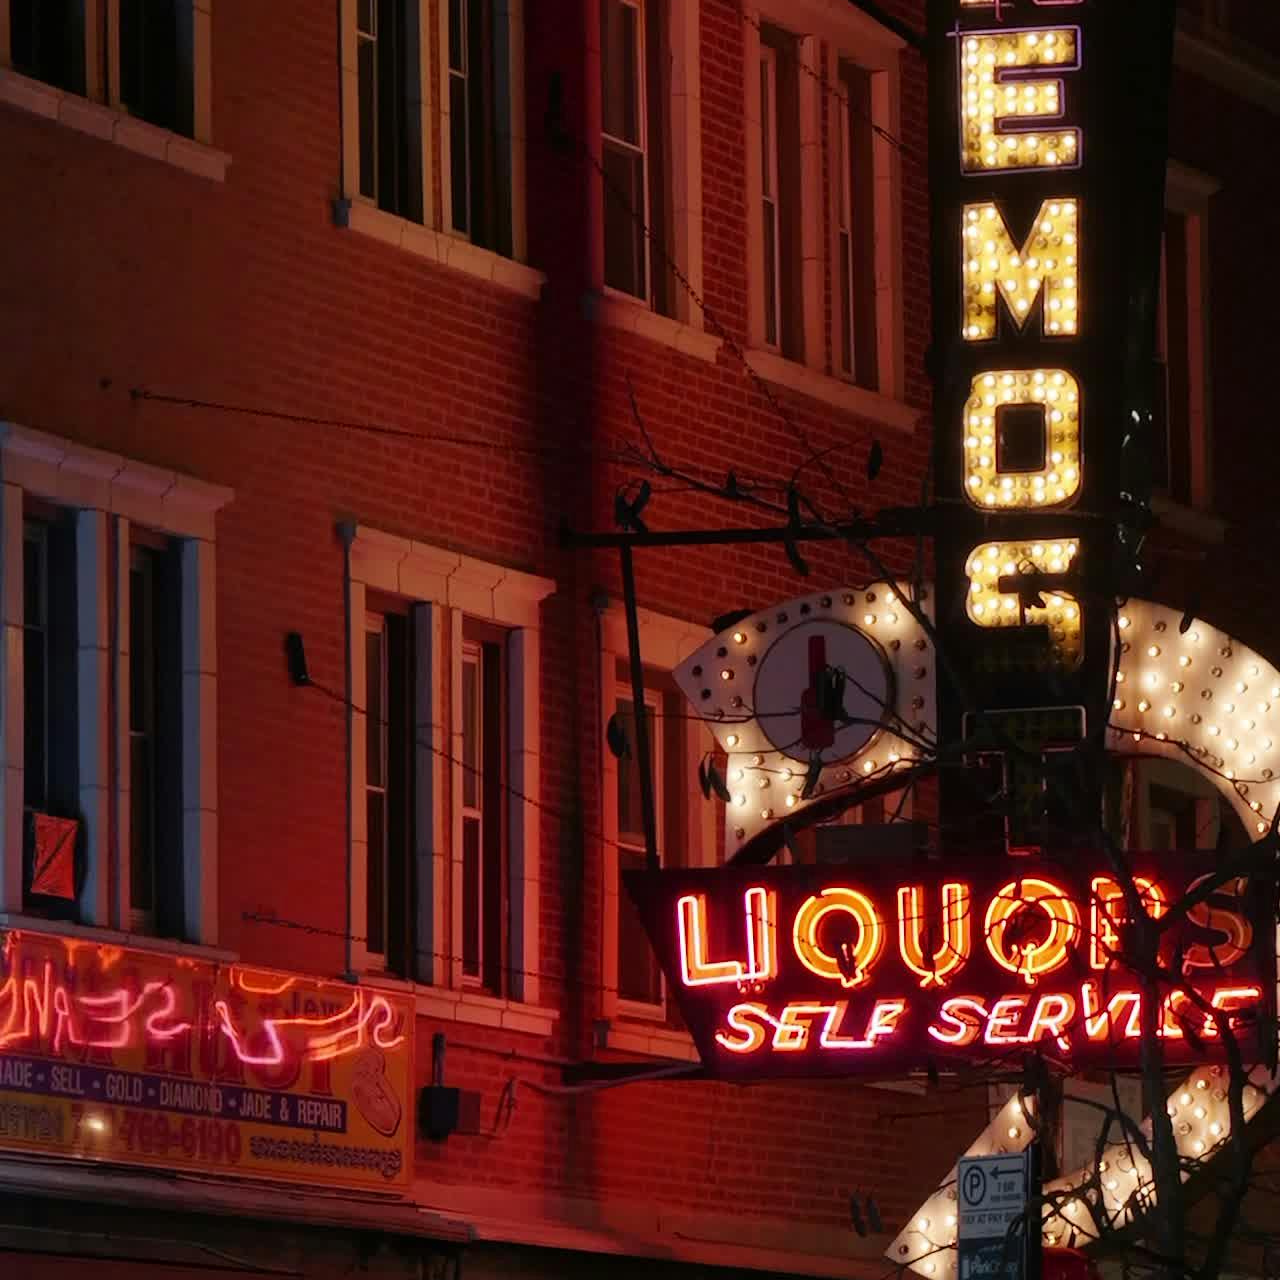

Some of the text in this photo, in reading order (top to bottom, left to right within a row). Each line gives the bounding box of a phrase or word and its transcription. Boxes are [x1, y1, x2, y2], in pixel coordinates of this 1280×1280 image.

[676, 872, 1255, 988] LIQUORS
[715, 996, 906, 1053] SELF
[50, 1065, 85, 1095] SELL
[105, 1073, 143, 1104] GOLD
[159, 1084, 224, 1114] DIAMOND
[239, 1090, 273, 1121] JADE
[279, 1098, 290, 1122] &
[297, 1101, 343, 1129] REPAIR
